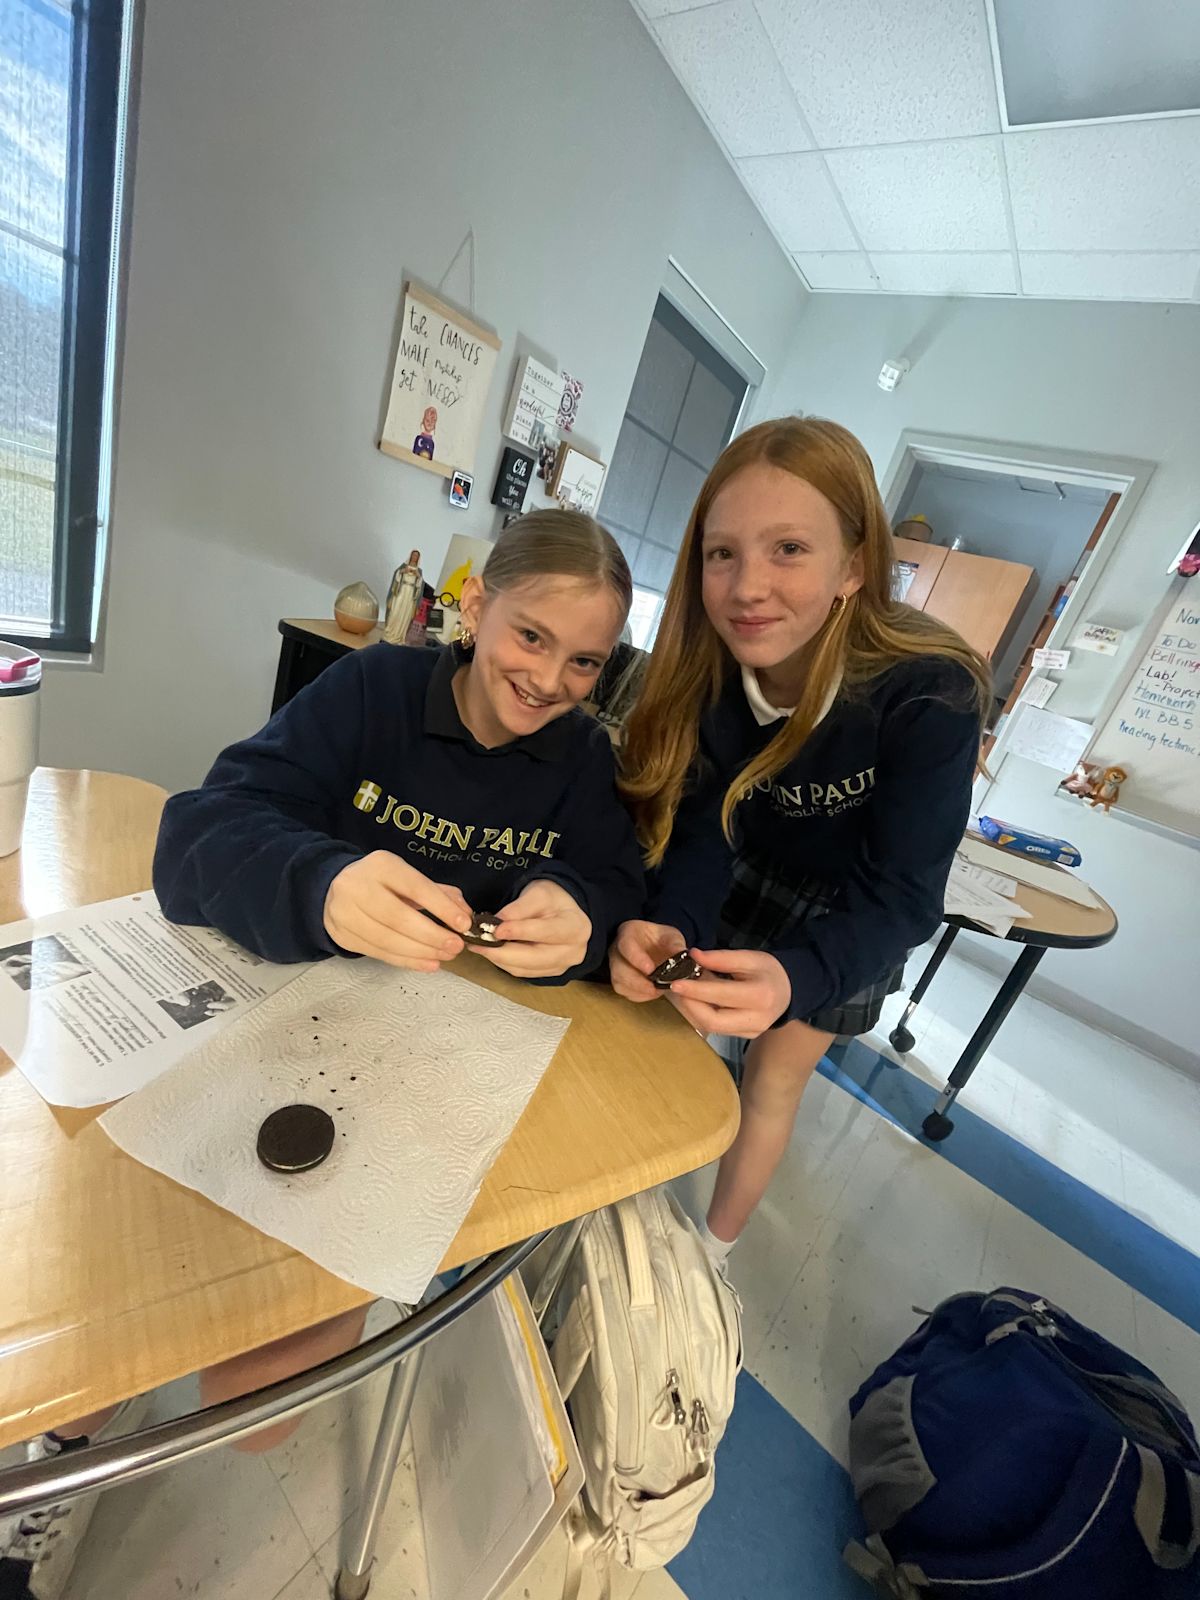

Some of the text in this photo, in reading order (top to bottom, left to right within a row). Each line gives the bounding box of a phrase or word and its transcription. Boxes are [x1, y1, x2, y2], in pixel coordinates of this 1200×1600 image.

[409, 305, 483, 366] take CHANCES
[400, 339, 430, 368] MAKE
[398, 369, 461, 409] get MESSY
[512, 458, 528, 477] Oh
[508, 484, 519, 497] You
[1177, 638, 1197, 650] Do
[1134, 680, 1196, 710] Homework
[375, 795, 475, 850] JOHN
[406, 839, 529, 871] CATHOIC SCOL
